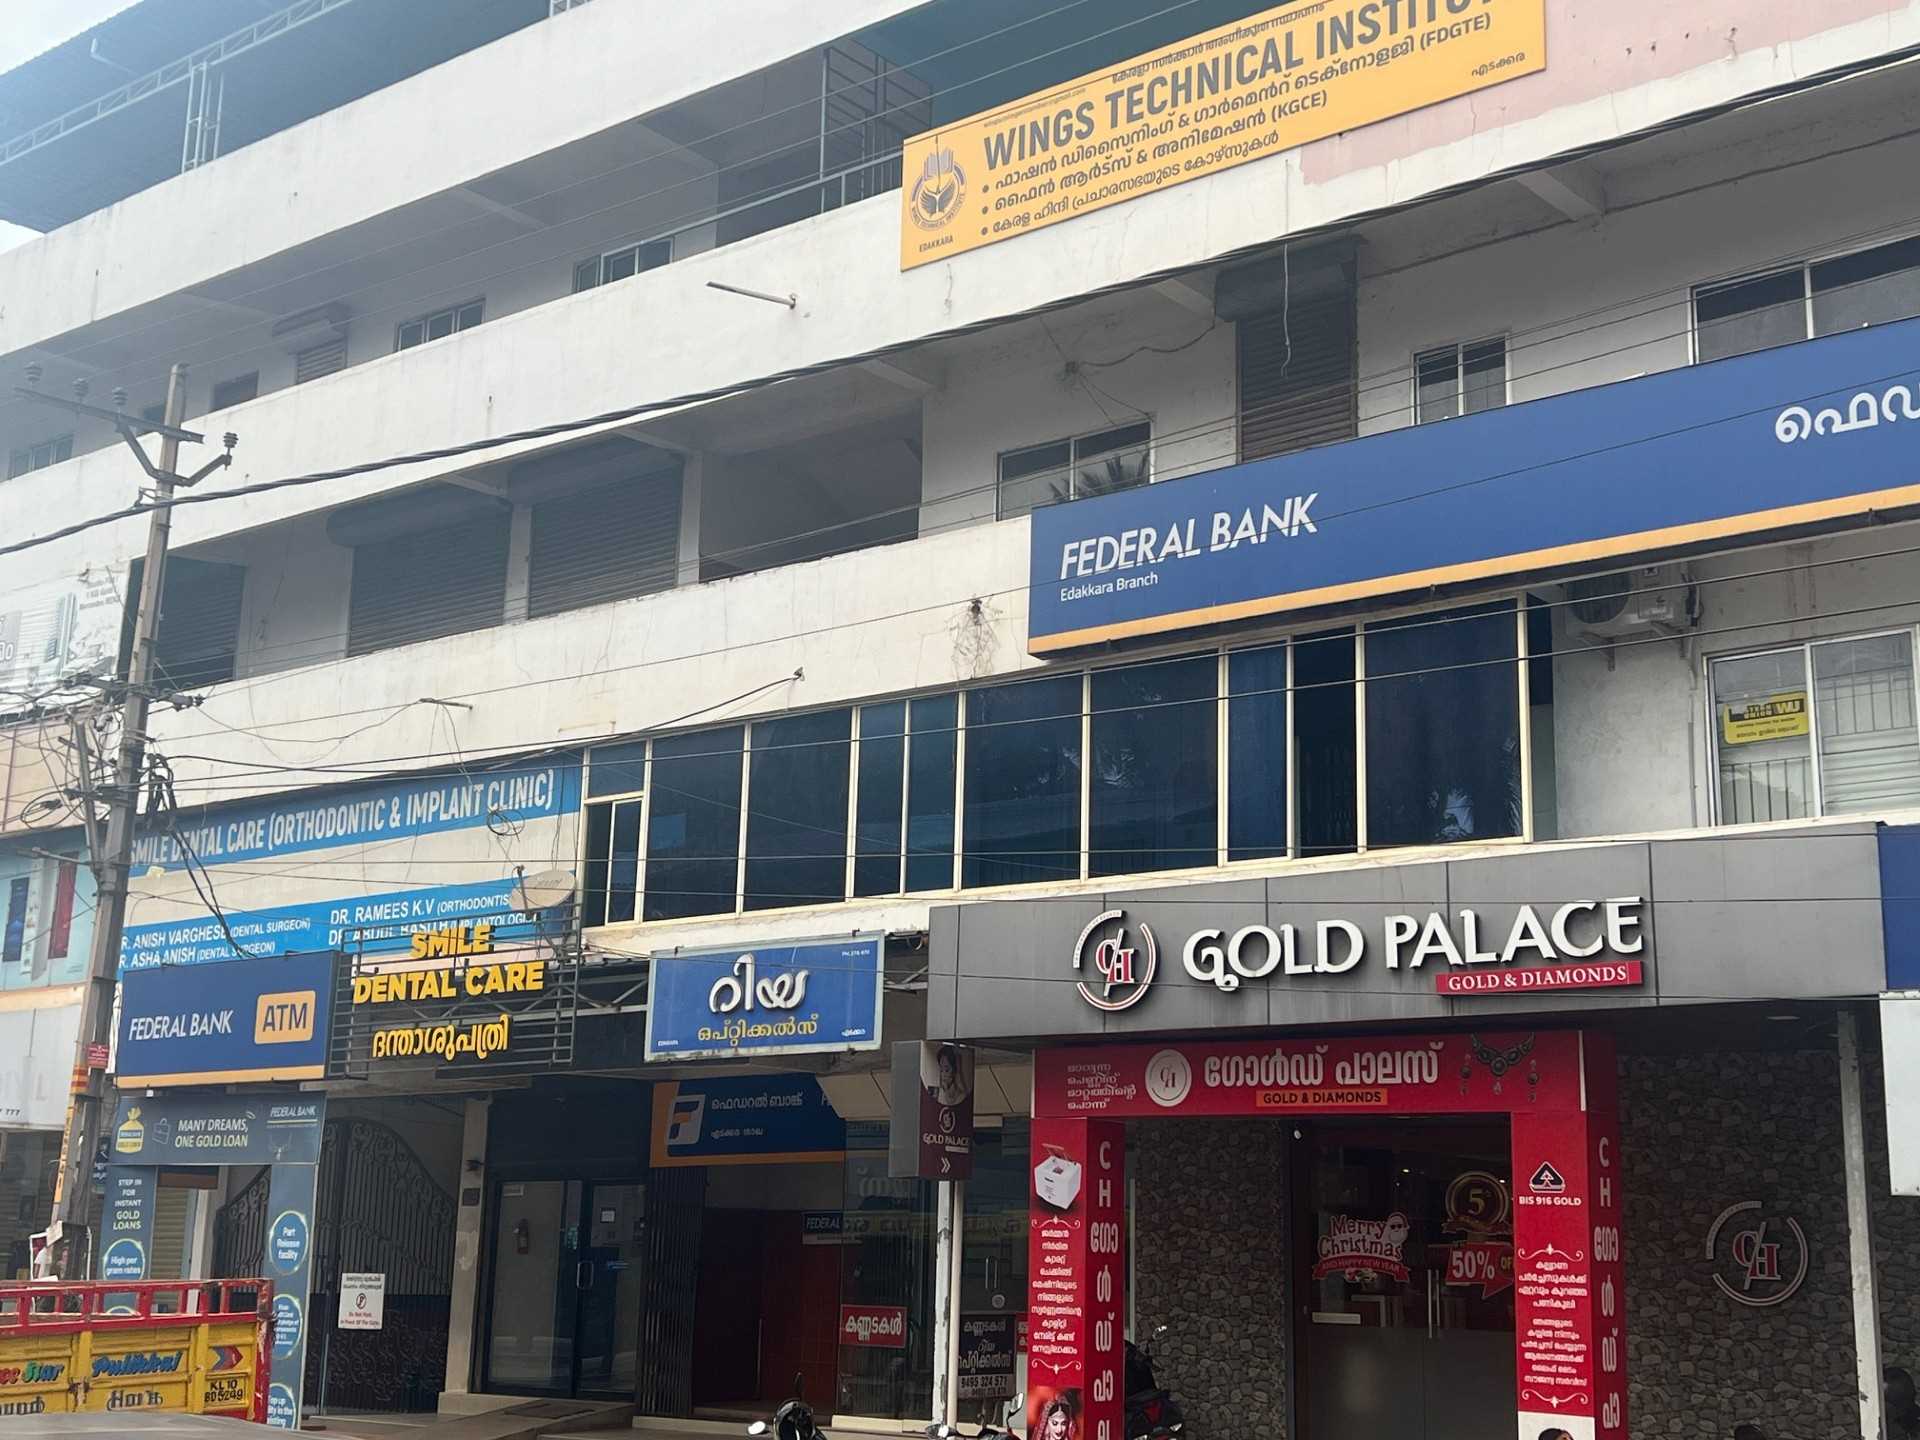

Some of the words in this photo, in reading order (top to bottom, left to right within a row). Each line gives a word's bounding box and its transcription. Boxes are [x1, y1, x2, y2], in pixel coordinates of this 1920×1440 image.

[983, 100, 1095, 171] WINGS
[1105, 31, 1303, 129] TECHNICAL
[995, 156, 1057, 190] ഫാഷൻ
[1178, 113, 1190, 129] &
[1420, 12, 1490, 50] (FDGTE)
[995, 178, 1055, 211] ഫൈൻ
[1136, 150, 1148, 165] &
[1153, 109, 1266, 160] അനിമേഷൻ
[1271, 89, 1327, 123] (KGCE)
[993, 211, 1031, 233] കേരള
[1034, 195, 1069, 220] ഹിന്ദി
[919, 235, 954, 252] EDAKKARA
[1060, 518, 1201, 580] FEDERAL
[1210, 492, 1319, 553] BANK
[1060, 581, 1114, 602] Edakkara
[1116, 571, 1159, 592] Branch
[227, 818, 264, 851] CARE
[268, 799, 386, 850] (ORTHODONTIC
[390, 797, 401, 829] &
[406, 783, 484, 825] IMPLANT
[487, 768, 555, 812] CLINIC)
[331, 908, 349, 925] DR.
[355, 901, 409, 923] RAMEES
[412, 898, 435, 917] K.V
[437, 893, 512, 917] (ORTHODONTIS
[133, 930, 167, 949] ANISH
[168, 924, 227, 945] VARGHESE
[266, 917, 311, 934] SURGEON)
[410, 925, 492, 960] SMILE
[1182, 918, 1366, 993] GOLD
[1385, 896, 1644, 971] PALACE
[131, 950, 161, 969] ASHA
[163, 947, 197, 964] ANISH
[231, 942, 276, 958] SRGEON)
[353, 969, 457, 1005] DENTAL
[465, 960, 545, 997] CARE
[709, 953, 810, 1014] റിയ
[1448, 973, 1501, 991] GOLD
[1504, 972, 1517, 988] &
[1521, 965, 1629, 987] DIAMONDS
[128, 1014, 186, 1041] FEDERAL
[190, 1010, 234, 1037] BANK
[262, 1002, 308, 1033] ATM
[372, 1013, 511, 1061] ദന്താശുപത്രി
[1204, 1044, 1329, 1088] ഗോൾഡ്
[1335, 1041, 1444, 1086] പാലസ്
[270, 1107, 296, 1118] FEDERAL
[297, 1105, 316, 1116] BANK
[1263, 1092, 1298, 1104] GOLD
[1301, 1092, 1309, 1103] &
[1312, 1091, 1382, 1104] DIAMONDS
[178, 1119, 207, 1132] MANY
[208, 1118, 249, 1133] DREAMS,
[922, 1133, 944, 1145] GOLD
[175, 1135, 195, 1148] ONE
[196, 1135, 222, 1148] GOLD
[223, 1134, 248, 1147] LOAN
[118, 1179, 132, 1187] STEP
[122, 1189, 135, 1197] FOR
[115, 1199, 142, 1207] INSTANT
[116, 1210, 140, 1220] GOLD
[1519, 1196, 1534, 1205] BIS
[1536, 1196, 1552, 1205] 916
[1553, 1196, 1582, 1206] GOLD
[113, 1220, 142, 1231] LOANS
[1327, 1215, 1387, 1239] Merry
[1318, 1235, 1403, 1261] Christmas
[1451, 1251, 1495, 1280] 50%
[845, 1312, 902, 1341] കണ്ണടകൾ
[210, 1379, 224, 1391] KL
[226, 1379, 238, 1390] 10
[107, 1389, 163, 1411] Horn
